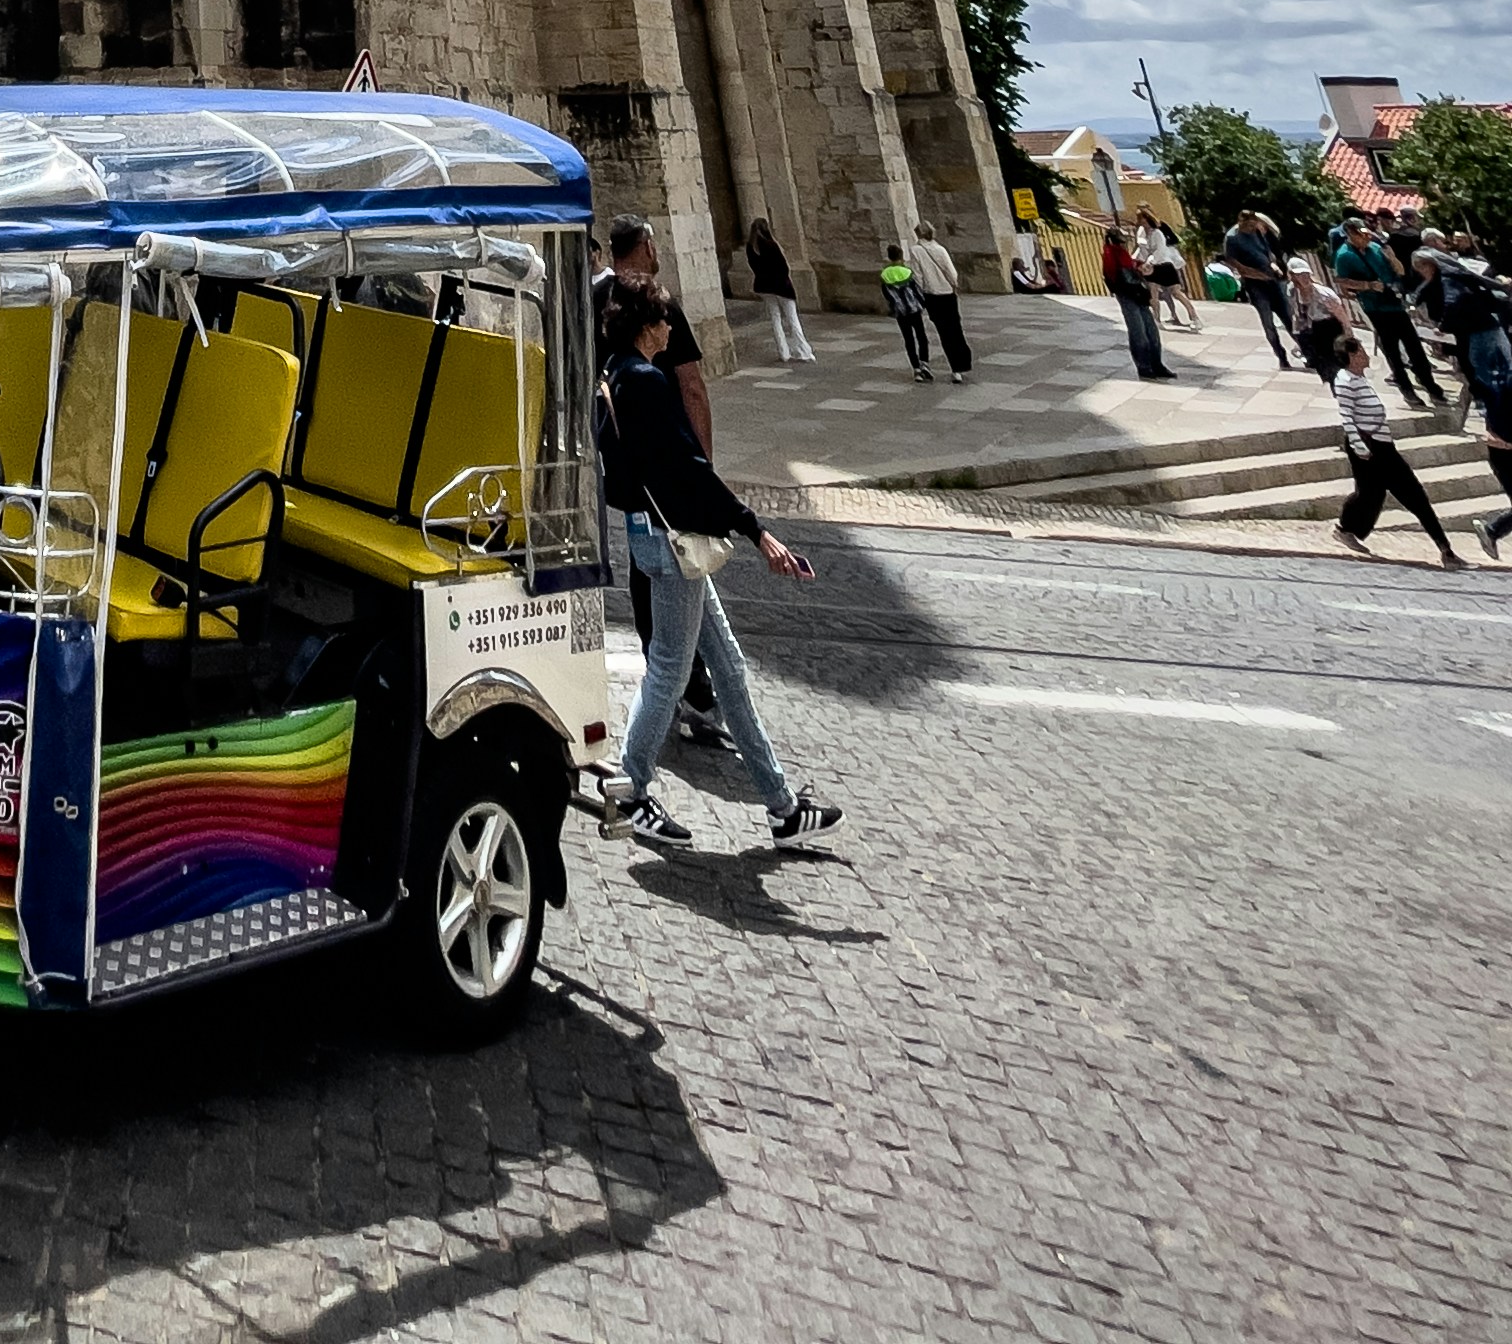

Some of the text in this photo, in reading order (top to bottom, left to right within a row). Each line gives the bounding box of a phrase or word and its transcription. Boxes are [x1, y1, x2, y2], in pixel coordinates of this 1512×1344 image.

[467, 599, 567, 625] +351 929 336 490
[467, 624, 567, 653] +351 915 593 087
